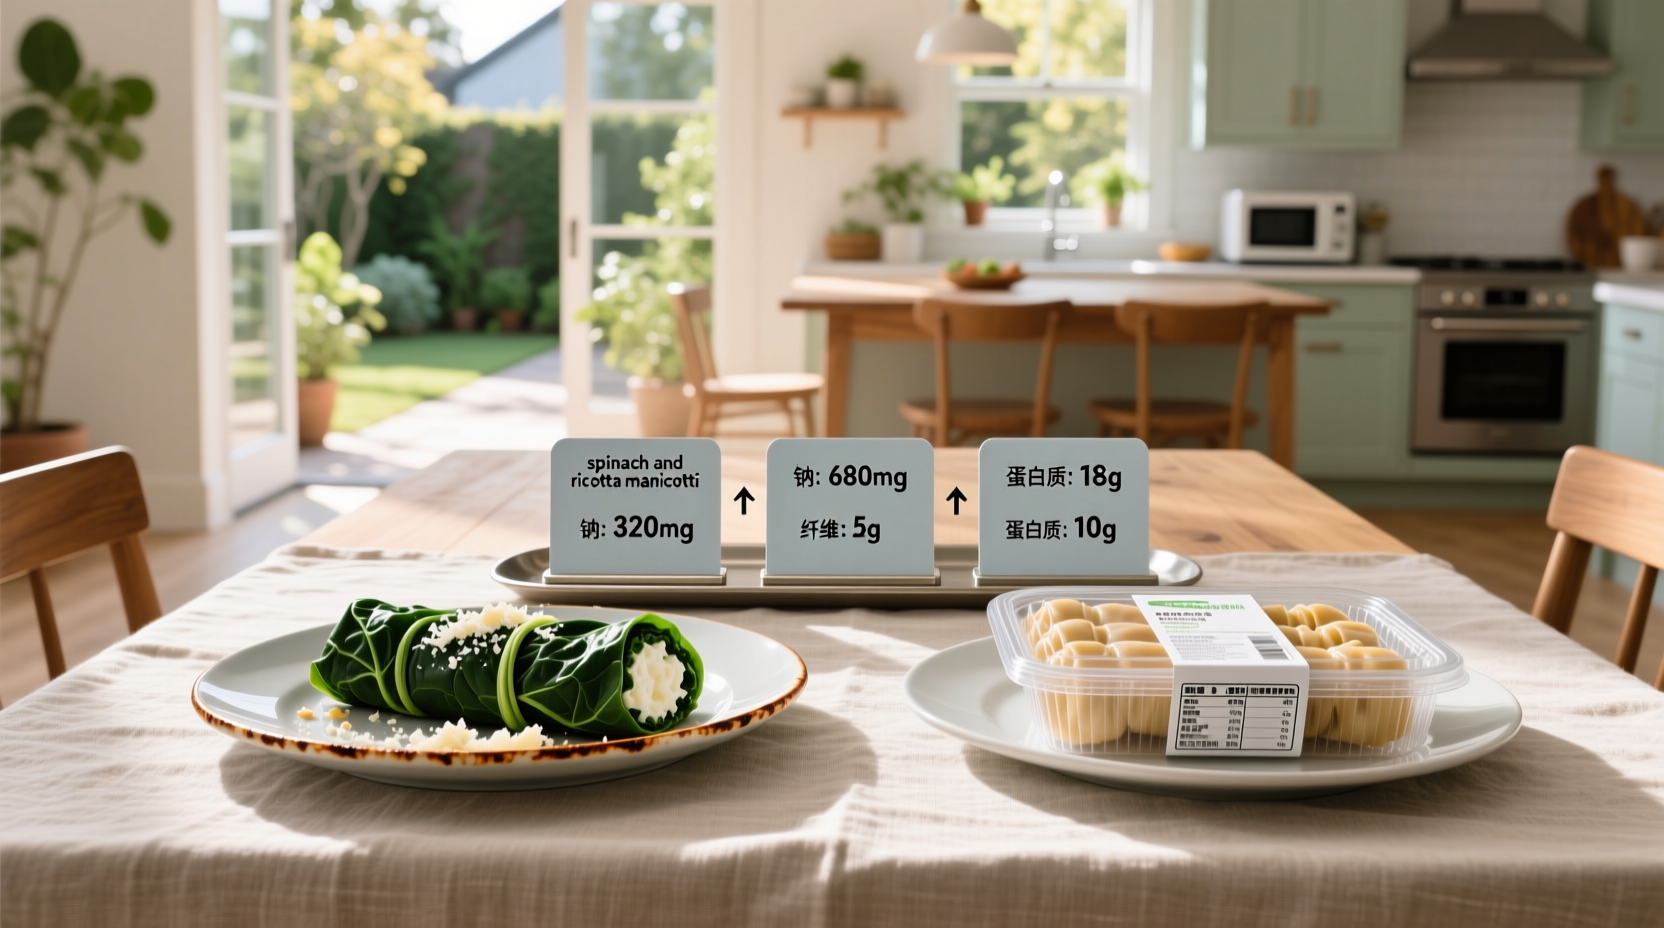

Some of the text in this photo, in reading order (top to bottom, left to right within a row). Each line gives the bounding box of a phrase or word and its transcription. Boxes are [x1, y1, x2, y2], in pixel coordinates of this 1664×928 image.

[587, 455, 682, 473] spinach and
[1080, 464, 1121, 492] 18g
[571, 472, 700, 488] ricotta manicotti
[829, 465, 907, 492] 680mg
[614, 515, 693, 544] 320mg
[852, 516, 880, 544] 5g
[1075, 516, 1116, 544] 10g
